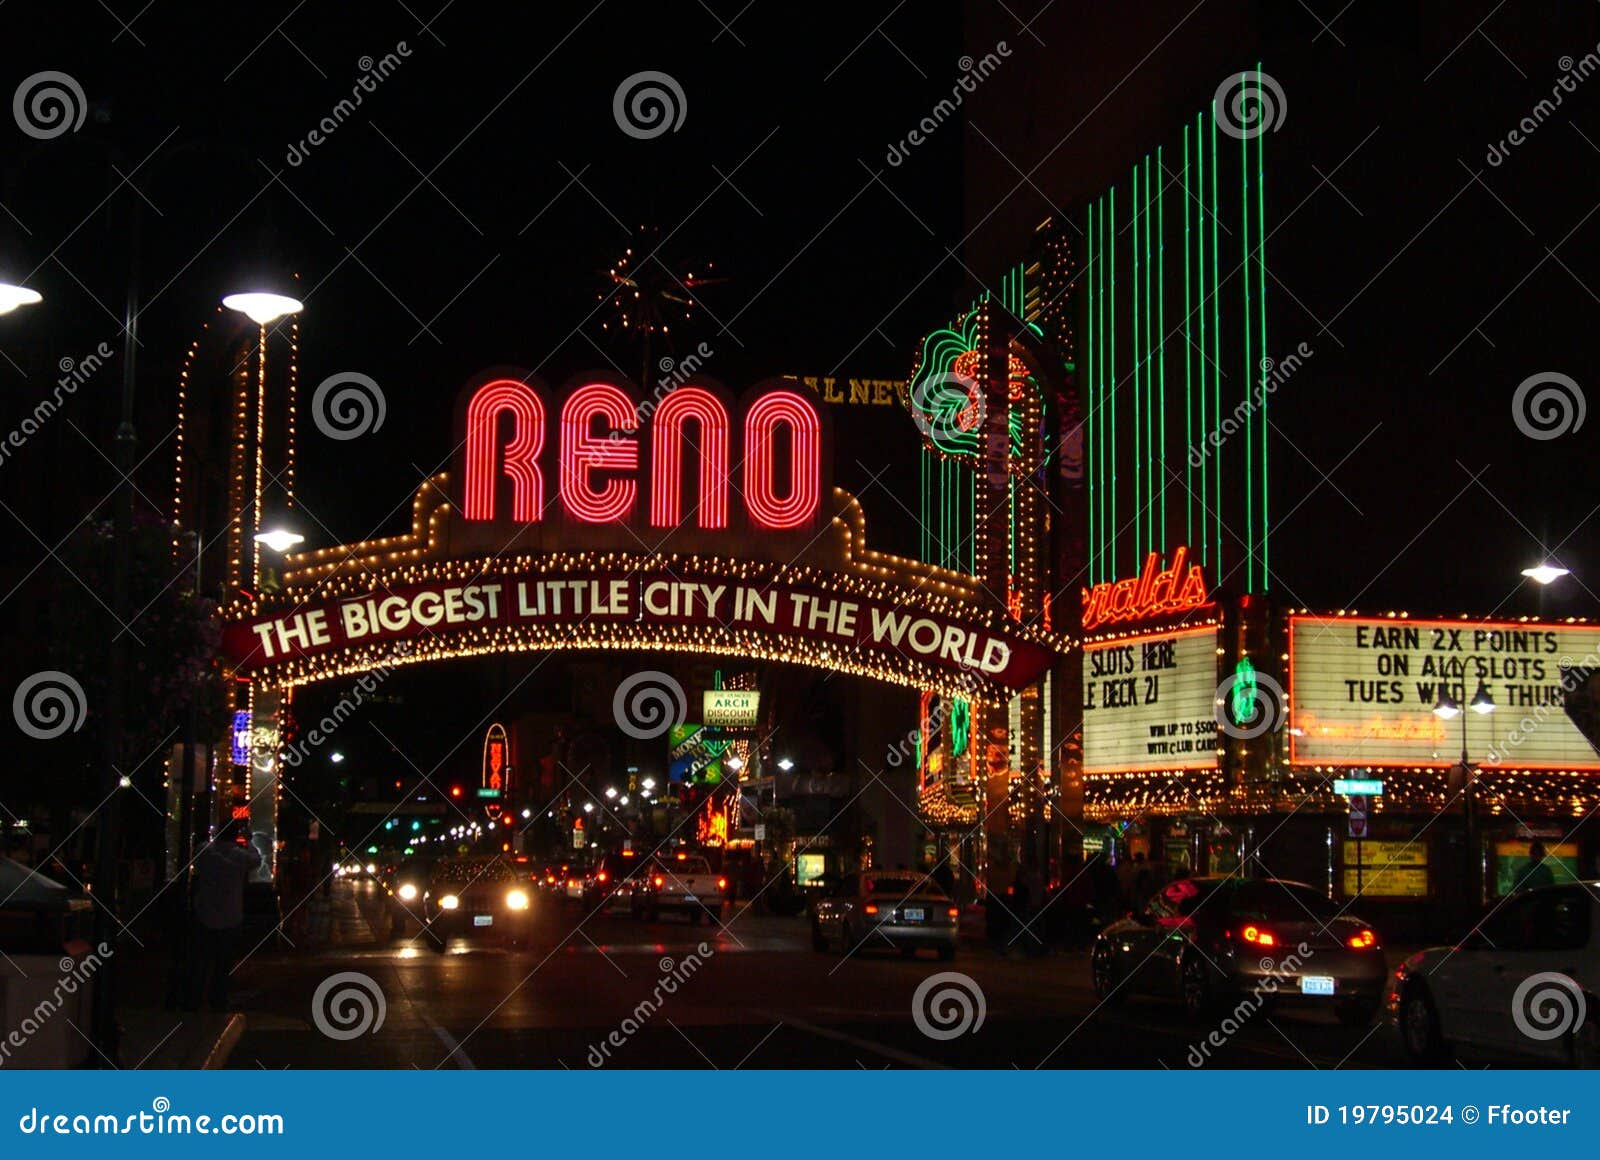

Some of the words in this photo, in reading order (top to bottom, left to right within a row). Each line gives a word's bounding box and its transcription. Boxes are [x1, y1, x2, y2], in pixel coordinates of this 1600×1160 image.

[463, 379, 821, 529] RENO
[252, 609, 332, 659] THE
[341, 584, 502, 639] BIGGEST
[517, 580, 630, 616] LITTLE
[643, 581, 727, 618] CITY
[734, 587, 777, 625] IN
[790, 594, 859, 637] THE
[871, 608, 1010, 674] WORLD
[1356, 626, 1420, 650] EARN
[1432, 628, 1464, 652] 2X
[1474, 629, 1558, 653] POINTS
[1091, 644, 1134, 678] SLOTS
[1142, 639, 1177, 671] HERE
[1377, 654, 1409, 676] ON
[1474, 656, 1546, 680] SLOTS
[715, 699, 749, 708] ARCH
[1103, 677, 1138, 709] DECK
[1145, 675, 1158, 705] 21
[1345, 680, 1405, 704] TUES
[1416, 682, 1464, 704] WD
[707, 709, 756, 718] DISCOUNT
[1168, 723, 1179, 736] UP
[1181, 722, 1193, 735] TO
